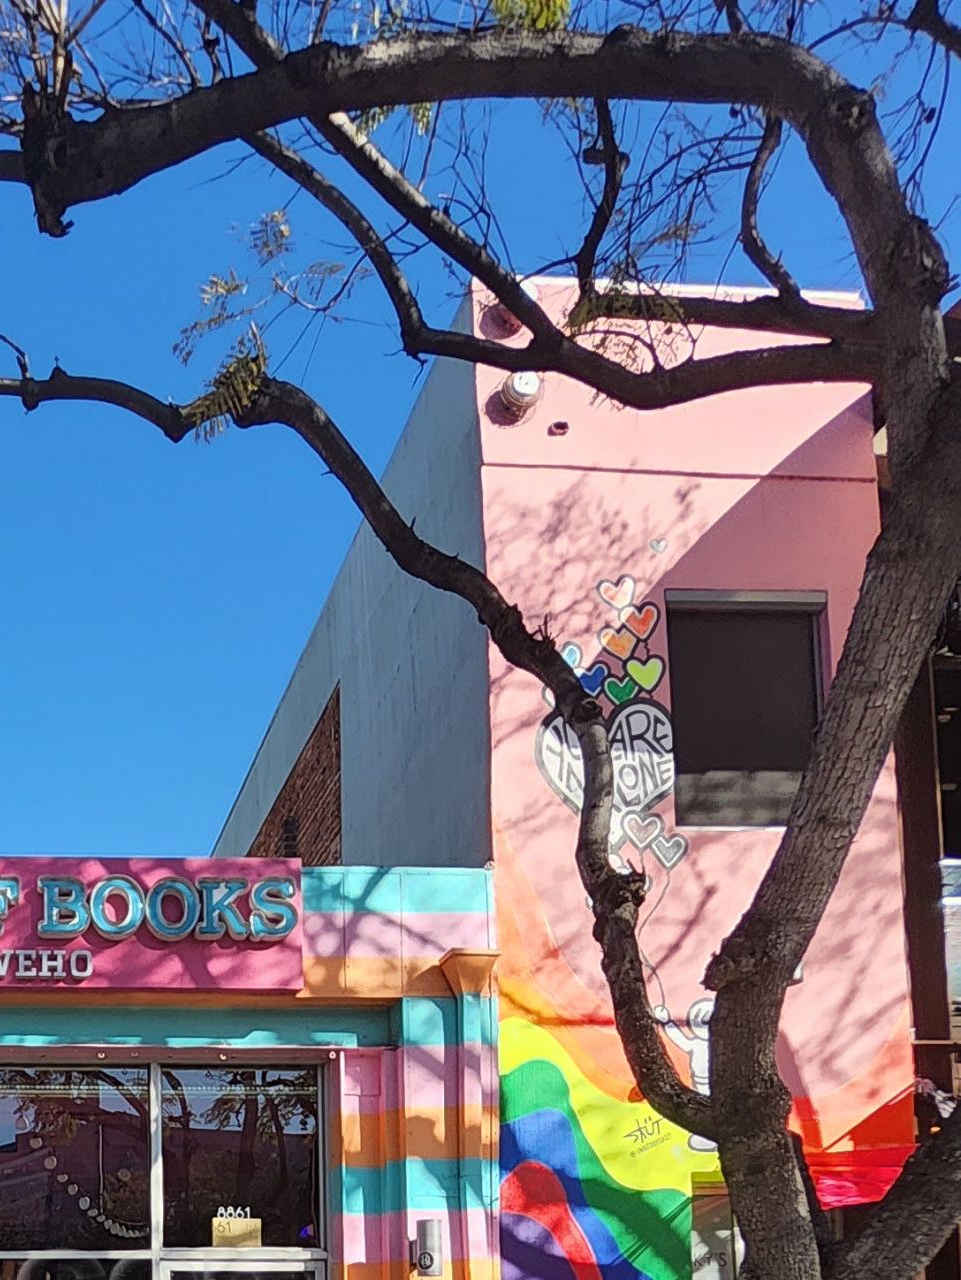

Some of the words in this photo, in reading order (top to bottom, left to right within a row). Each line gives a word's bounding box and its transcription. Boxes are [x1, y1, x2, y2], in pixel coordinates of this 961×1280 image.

[609, 709, 674, 761] ARE
[37, 877, 300, 940] BOOKS
[217, 1206, 251, 1219] 8861
